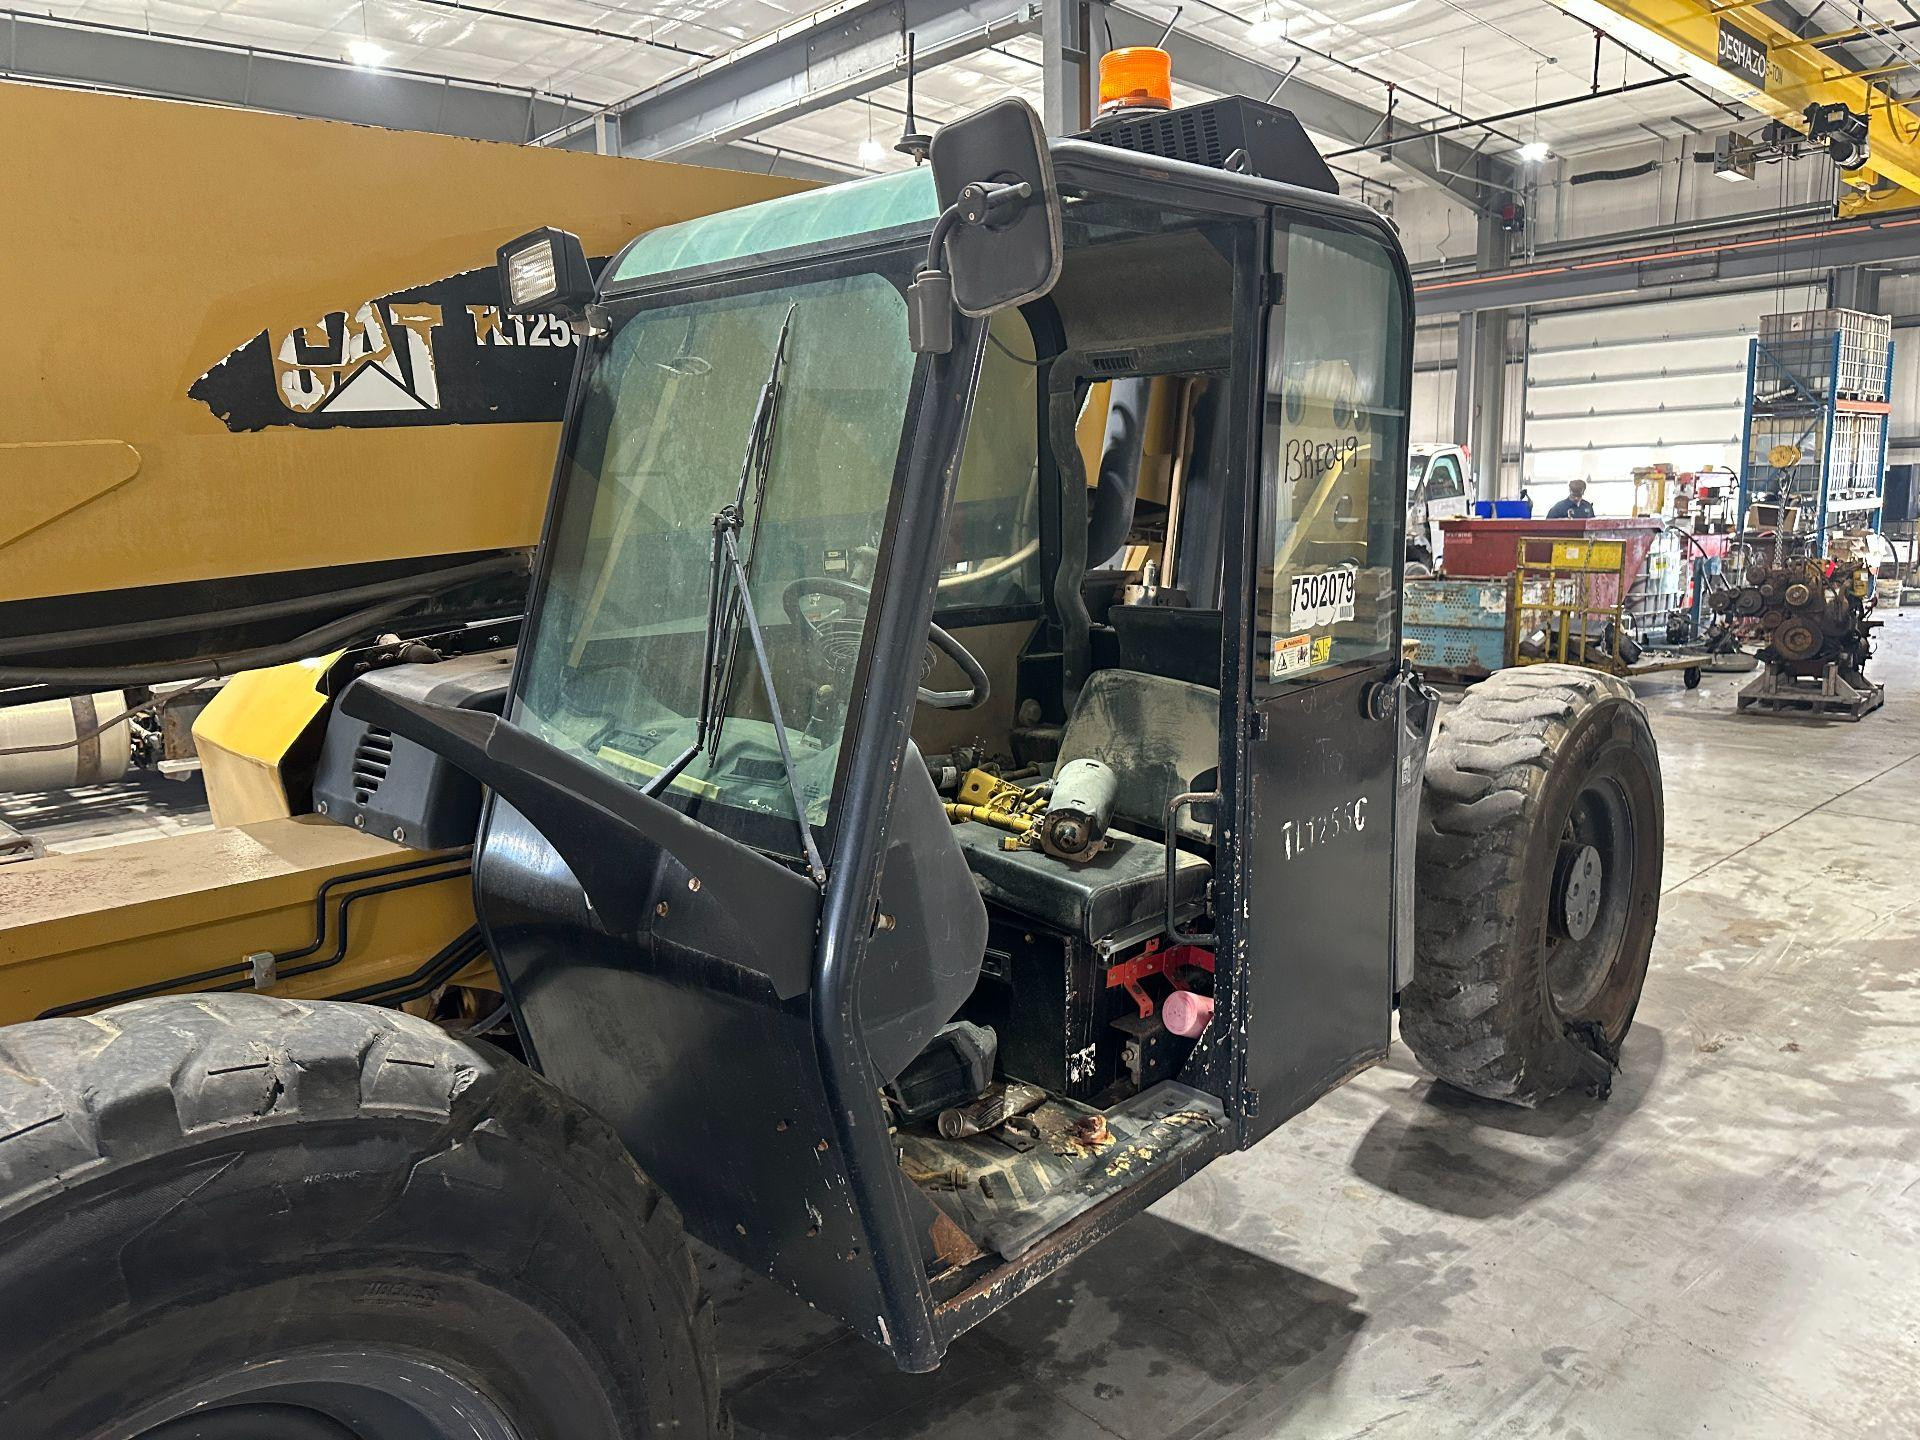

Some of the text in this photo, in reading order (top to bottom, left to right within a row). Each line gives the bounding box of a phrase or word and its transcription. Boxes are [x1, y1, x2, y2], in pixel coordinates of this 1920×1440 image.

[1719, 30, 1766, 78] DESHAZO
[465, 304, 580, 347] TL125
[270, 301, 444, 413] CAT
[1285, 436, 1358, 483] BRE049
[1292, 571, 1354, 612] 7502079
